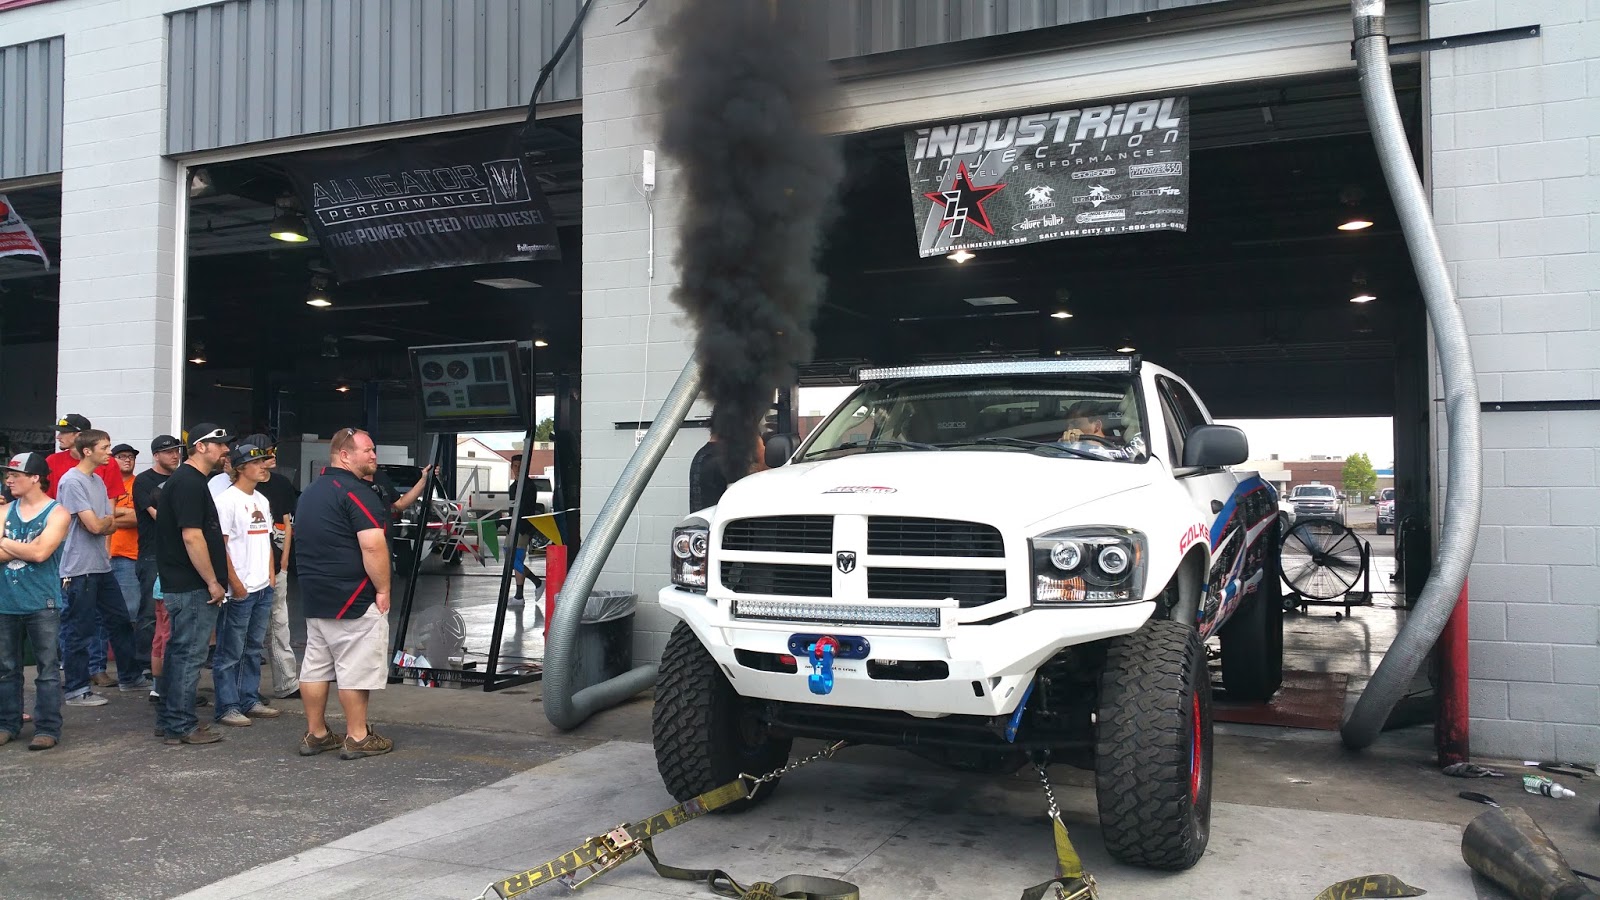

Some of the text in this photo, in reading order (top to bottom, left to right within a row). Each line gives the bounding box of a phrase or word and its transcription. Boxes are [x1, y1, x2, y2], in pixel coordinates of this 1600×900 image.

[1012, 148, 1155, 173] PERFORMANCE
[313, 164, 485, 208] ALLIGATOR
[328, 191, 482, 221] PERFORMANCE
[327, 230, 357, 248] THE
[355, 223, 407, 244] POWER
[406, 220, 427, 236] TO
[425, 215, 462, 235] FEED
[460, 213, 499, 230] YOUR
[1038, 232, 1058, 240] SALT
[1060, 229, 1080, 237] LAKE
[1179, 522, 1210, 556] FALKE
